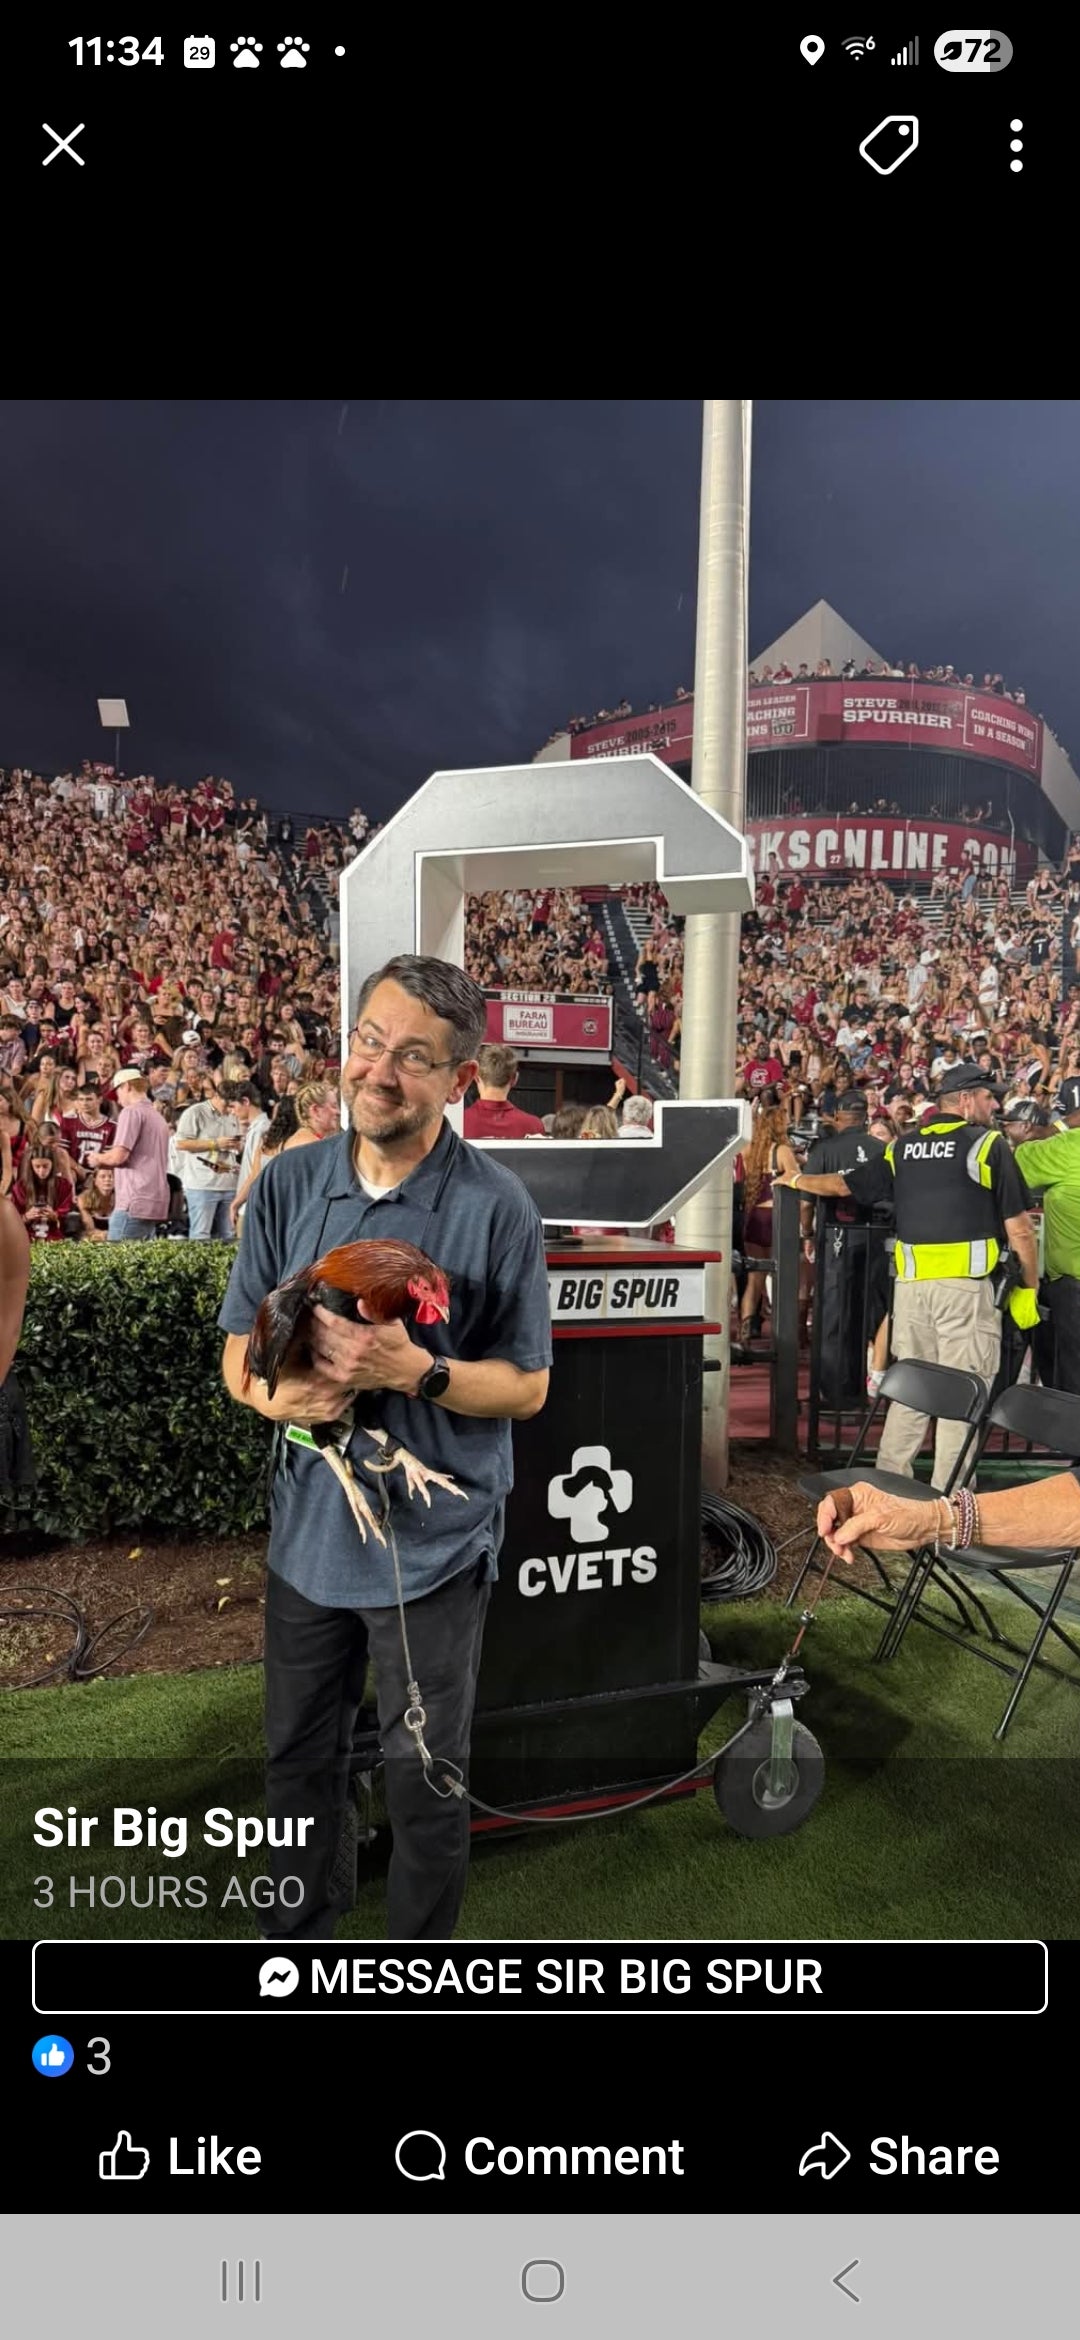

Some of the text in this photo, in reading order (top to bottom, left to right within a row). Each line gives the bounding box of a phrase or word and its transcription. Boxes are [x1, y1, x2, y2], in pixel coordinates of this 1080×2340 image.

[843, 698, 898, 709] STEVE
[747, 706, 795, 721] ACHING
[842, 709, 953, 729] SPURRIER
[970, 708, 1017, 732] COACHING
[974, 724, 986, 737] IN
[986, 727, 995, 739] A
[587, 735, 626, 754] STEVE
[829, 854, 841, 865] 27
[501, 991, 541, 1003] SECTION
[519, 1010, 548, 1020] FARM
[508, 1019, 549, 1030] BUREAU
[903, 1141, 956, 1160] POLICE
[557, 1278, 680, 1310] BIG SPUR
[518, 1546, 657, 1597] CVETS
